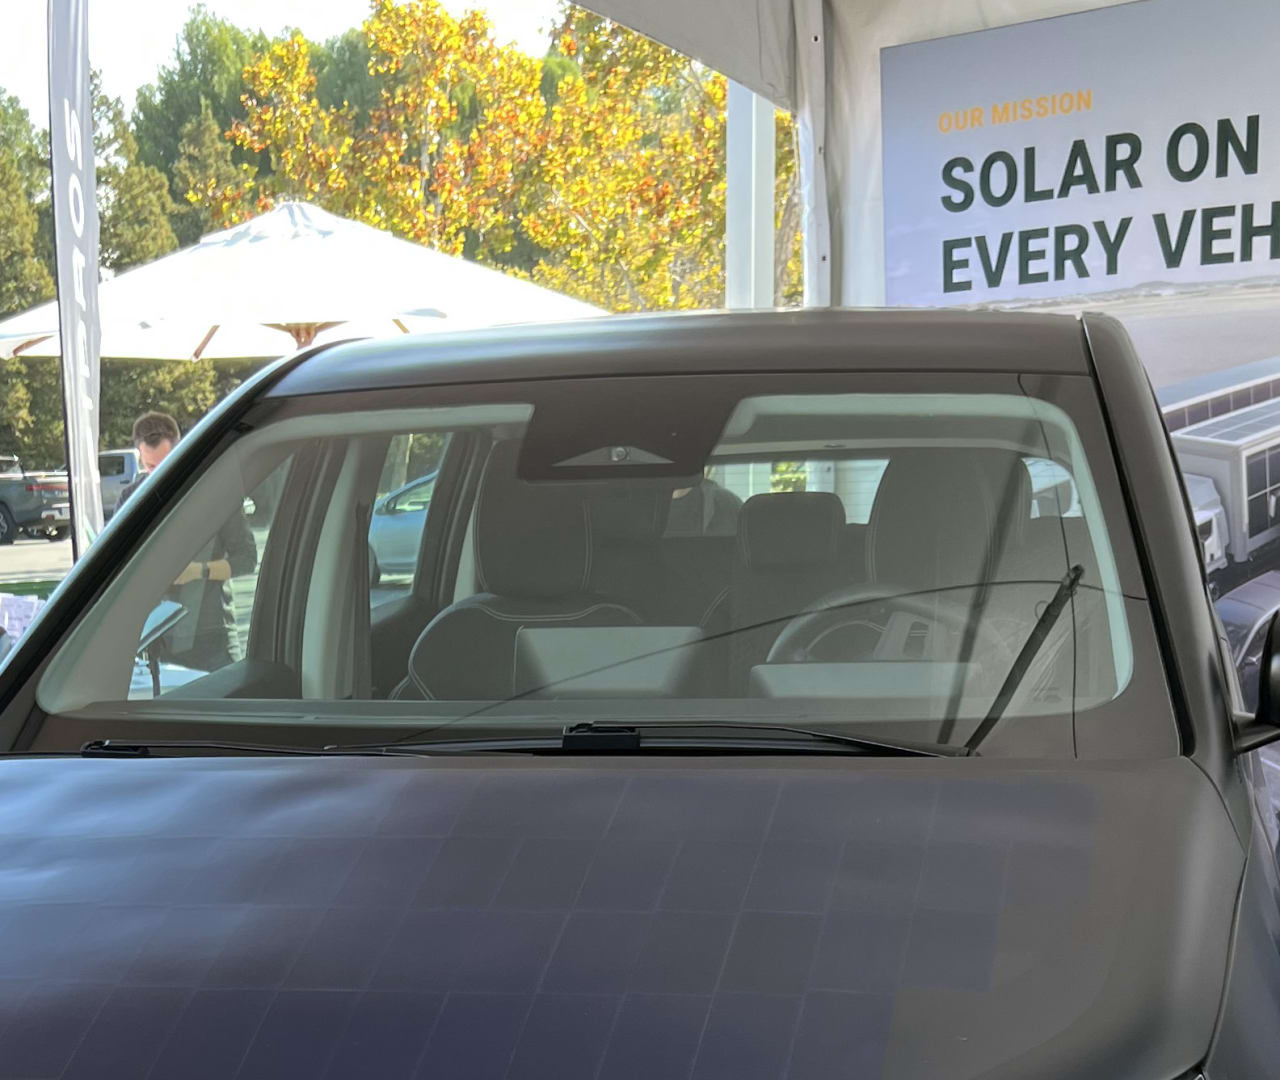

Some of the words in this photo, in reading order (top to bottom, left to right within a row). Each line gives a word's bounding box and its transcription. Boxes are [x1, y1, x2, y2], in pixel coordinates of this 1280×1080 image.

[937, 106, 985, 134] OUR
[990, 89, 1094, 126] MISSION
[940, 131, 1143, 213] SOLAR
[1166, 114, 1260, 183] ON
[942, 216, 1133, 294] EVERY
